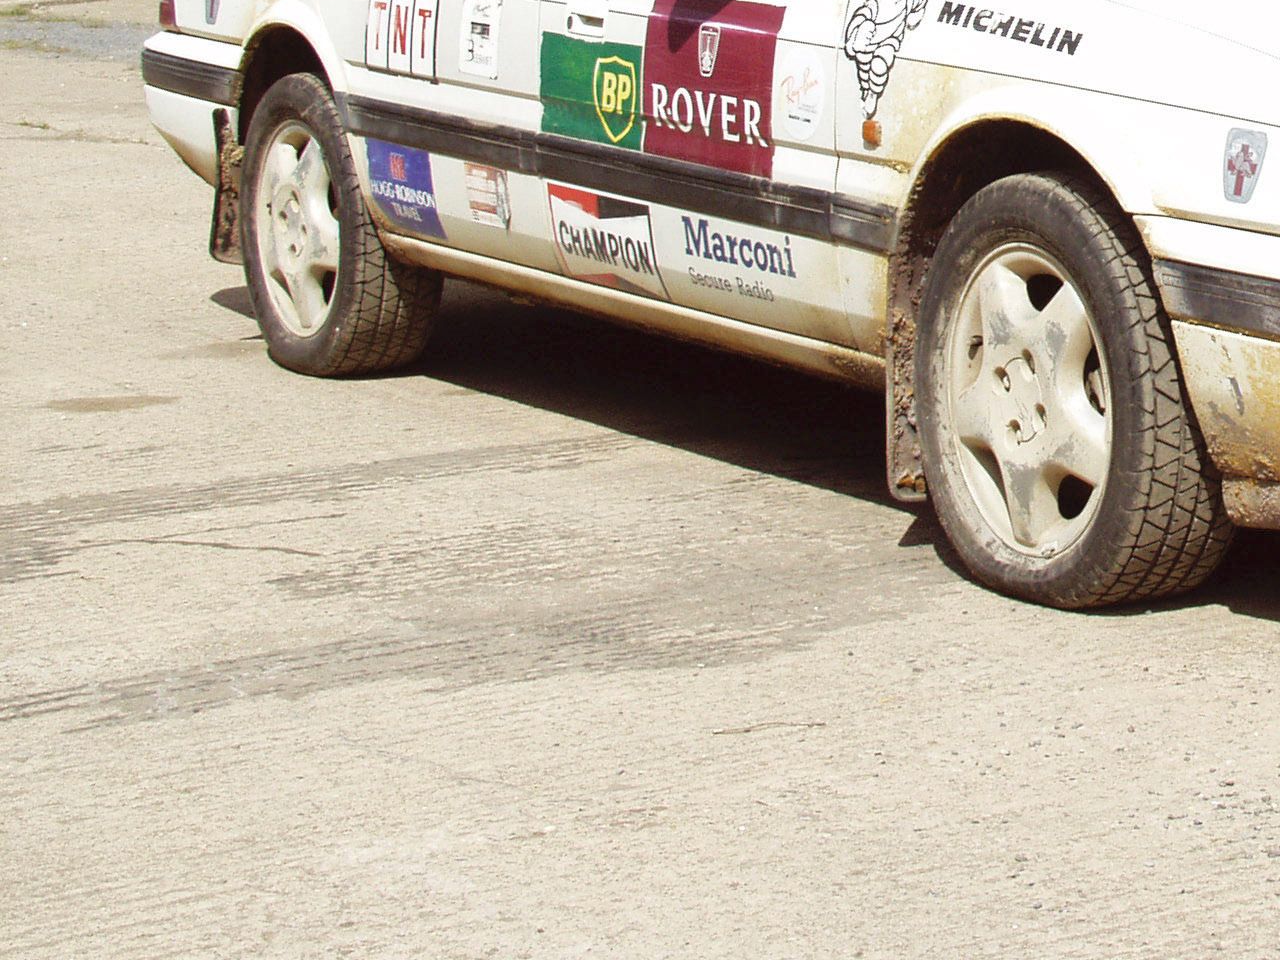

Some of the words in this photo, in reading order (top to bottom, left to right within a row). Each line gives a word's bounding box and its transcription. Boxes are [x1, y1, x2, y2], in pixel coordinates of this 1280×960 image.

[374, 0, 432, 59] TNT
[937, 0, 1084, 56] MICHELIN
[601, 71, 633, 114] BP
[652, 83, 769, 148] ROVER
[559, 220, 655, 276] CHAMPION
[681, 216, 797, 279] Marconi
[688, 267, 733, 292] Secure
[735, 276, 775, 303] Radio
